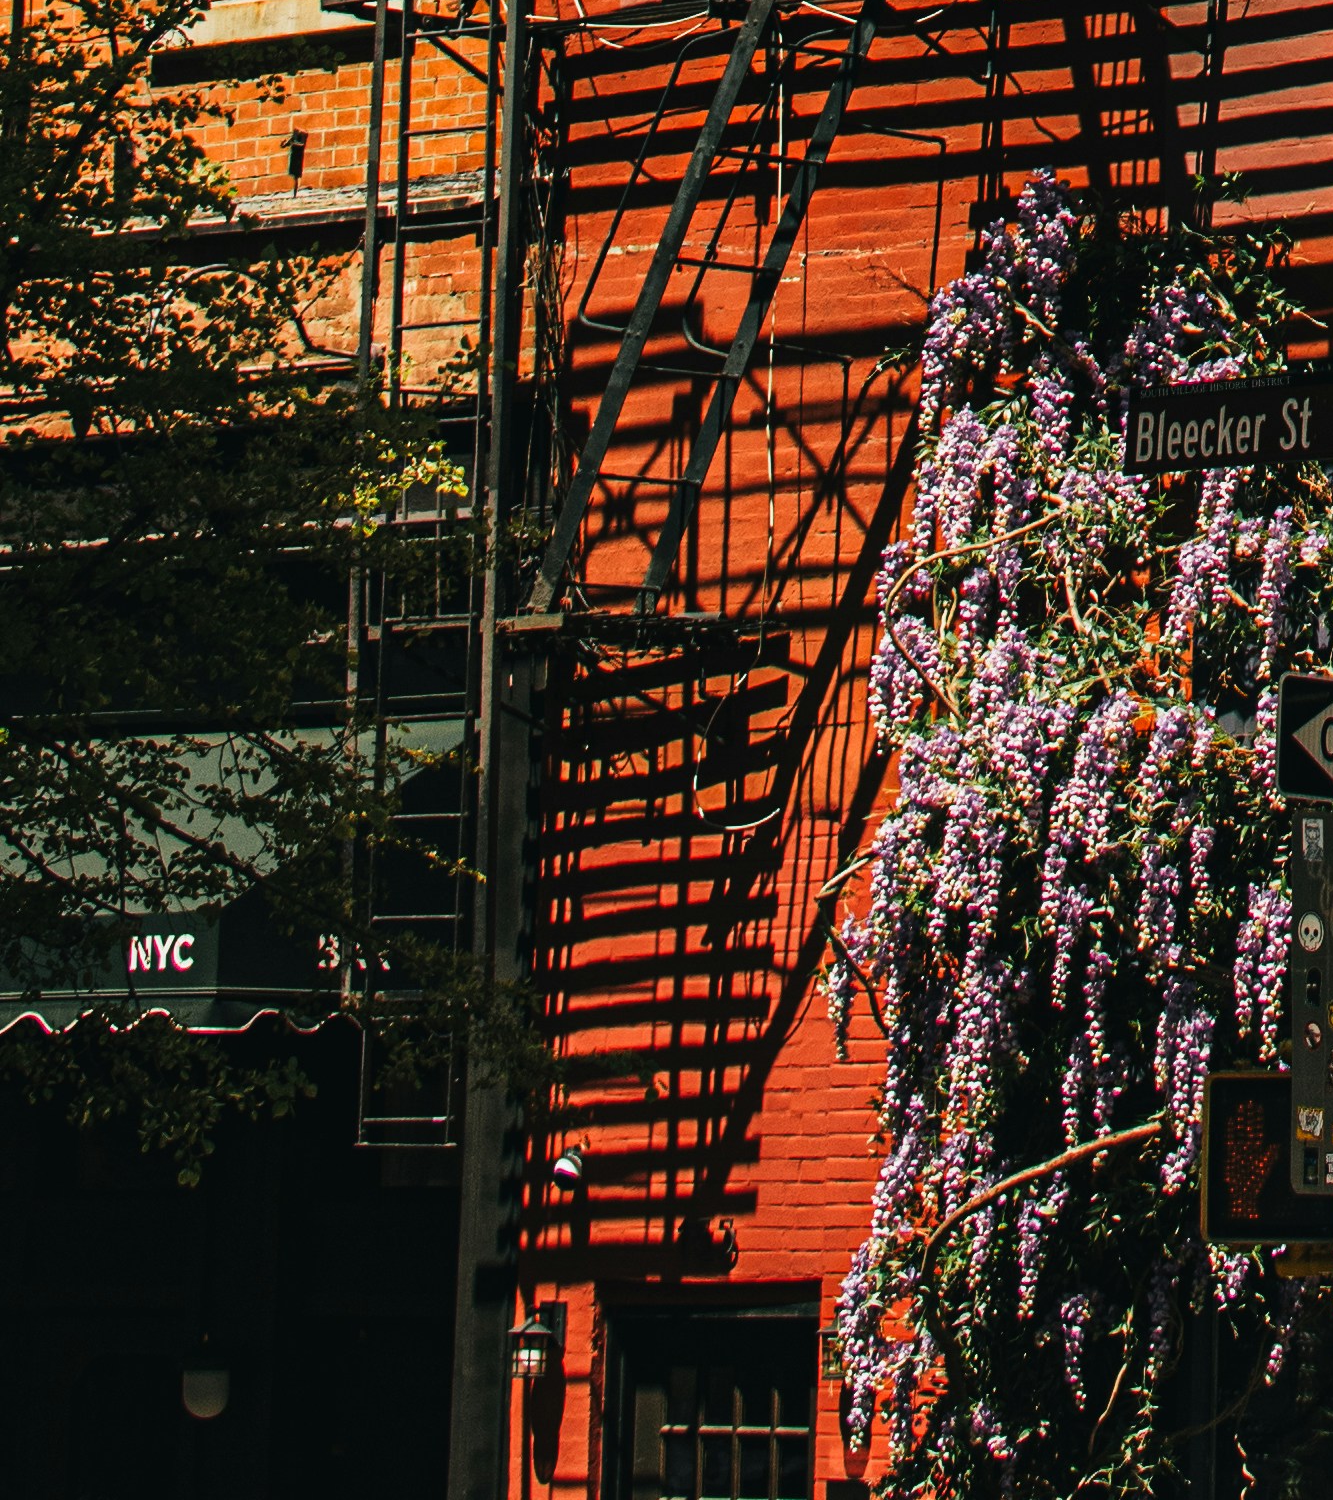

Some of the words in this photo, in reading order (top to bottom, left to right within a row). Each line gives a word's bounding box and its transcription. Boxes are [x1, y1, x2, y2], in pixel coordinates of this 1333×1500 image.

[1140, 386, 1168, 399] SOUTH
[1171, 383, 1206, 396] VILLAGE
[1209, 379, 1248, 392] HISTORIC
[1251, 375, 1293, 388] DISTRICT
[1135, 404, 1267, 463] Bleecker
[1279, 397, 1312, 451] St
[128, 933, 196, 973] NYC
